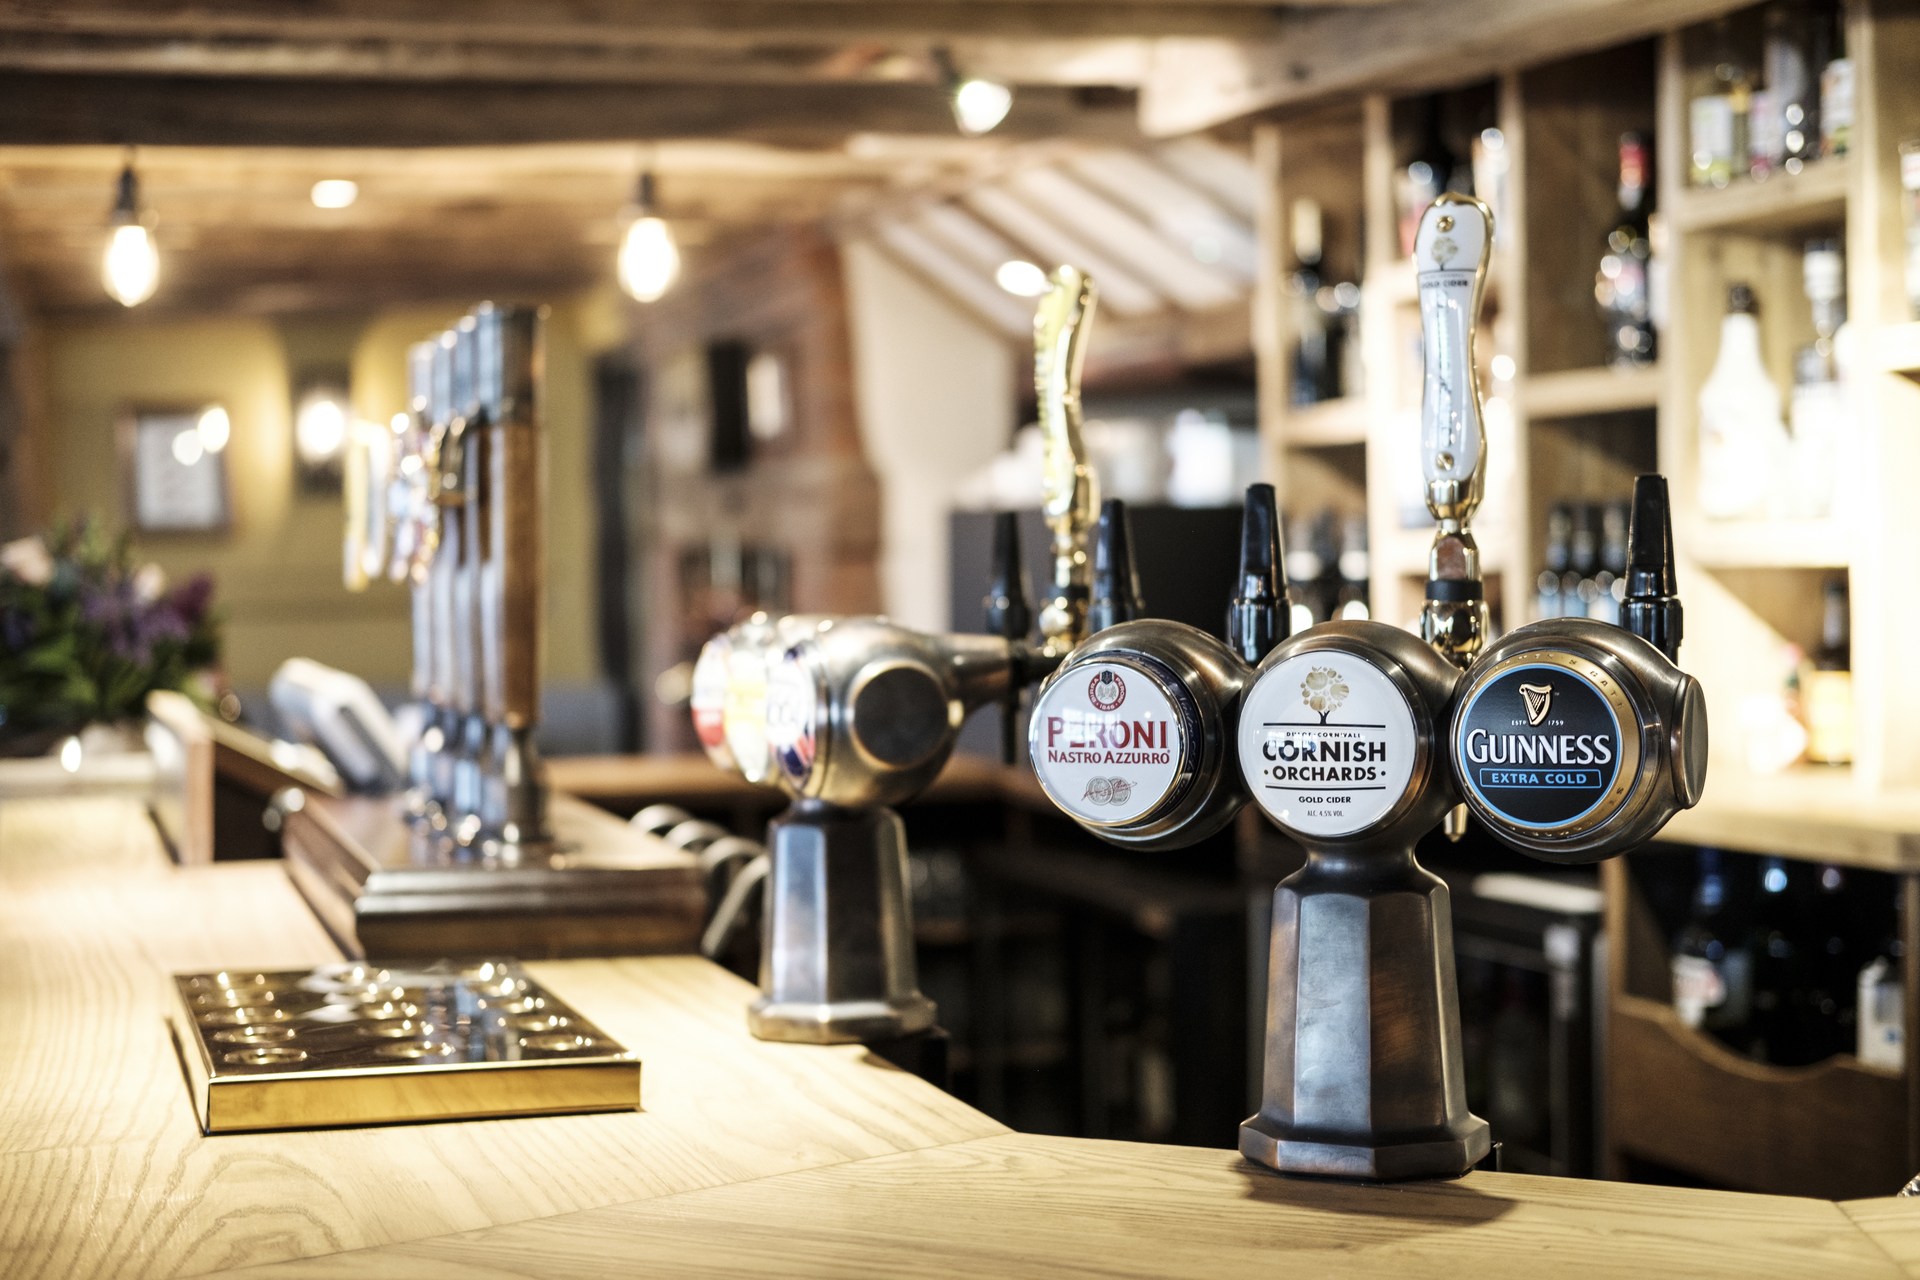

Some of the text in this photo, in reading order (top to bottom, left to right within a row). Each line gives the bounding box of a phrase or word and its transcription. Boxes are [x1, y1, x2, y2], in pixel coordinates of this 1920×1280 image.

[1263, 740, 1386, 762] CORNISH
[1466, 728, 1612, 764] GUINNESS
[1048, 750, 1170, 764] NASTRO AZZURRO
[1272, 765, 1377, 781] ORCHARDS
[1491, 773, 1587, 784] EXTRA COLD
